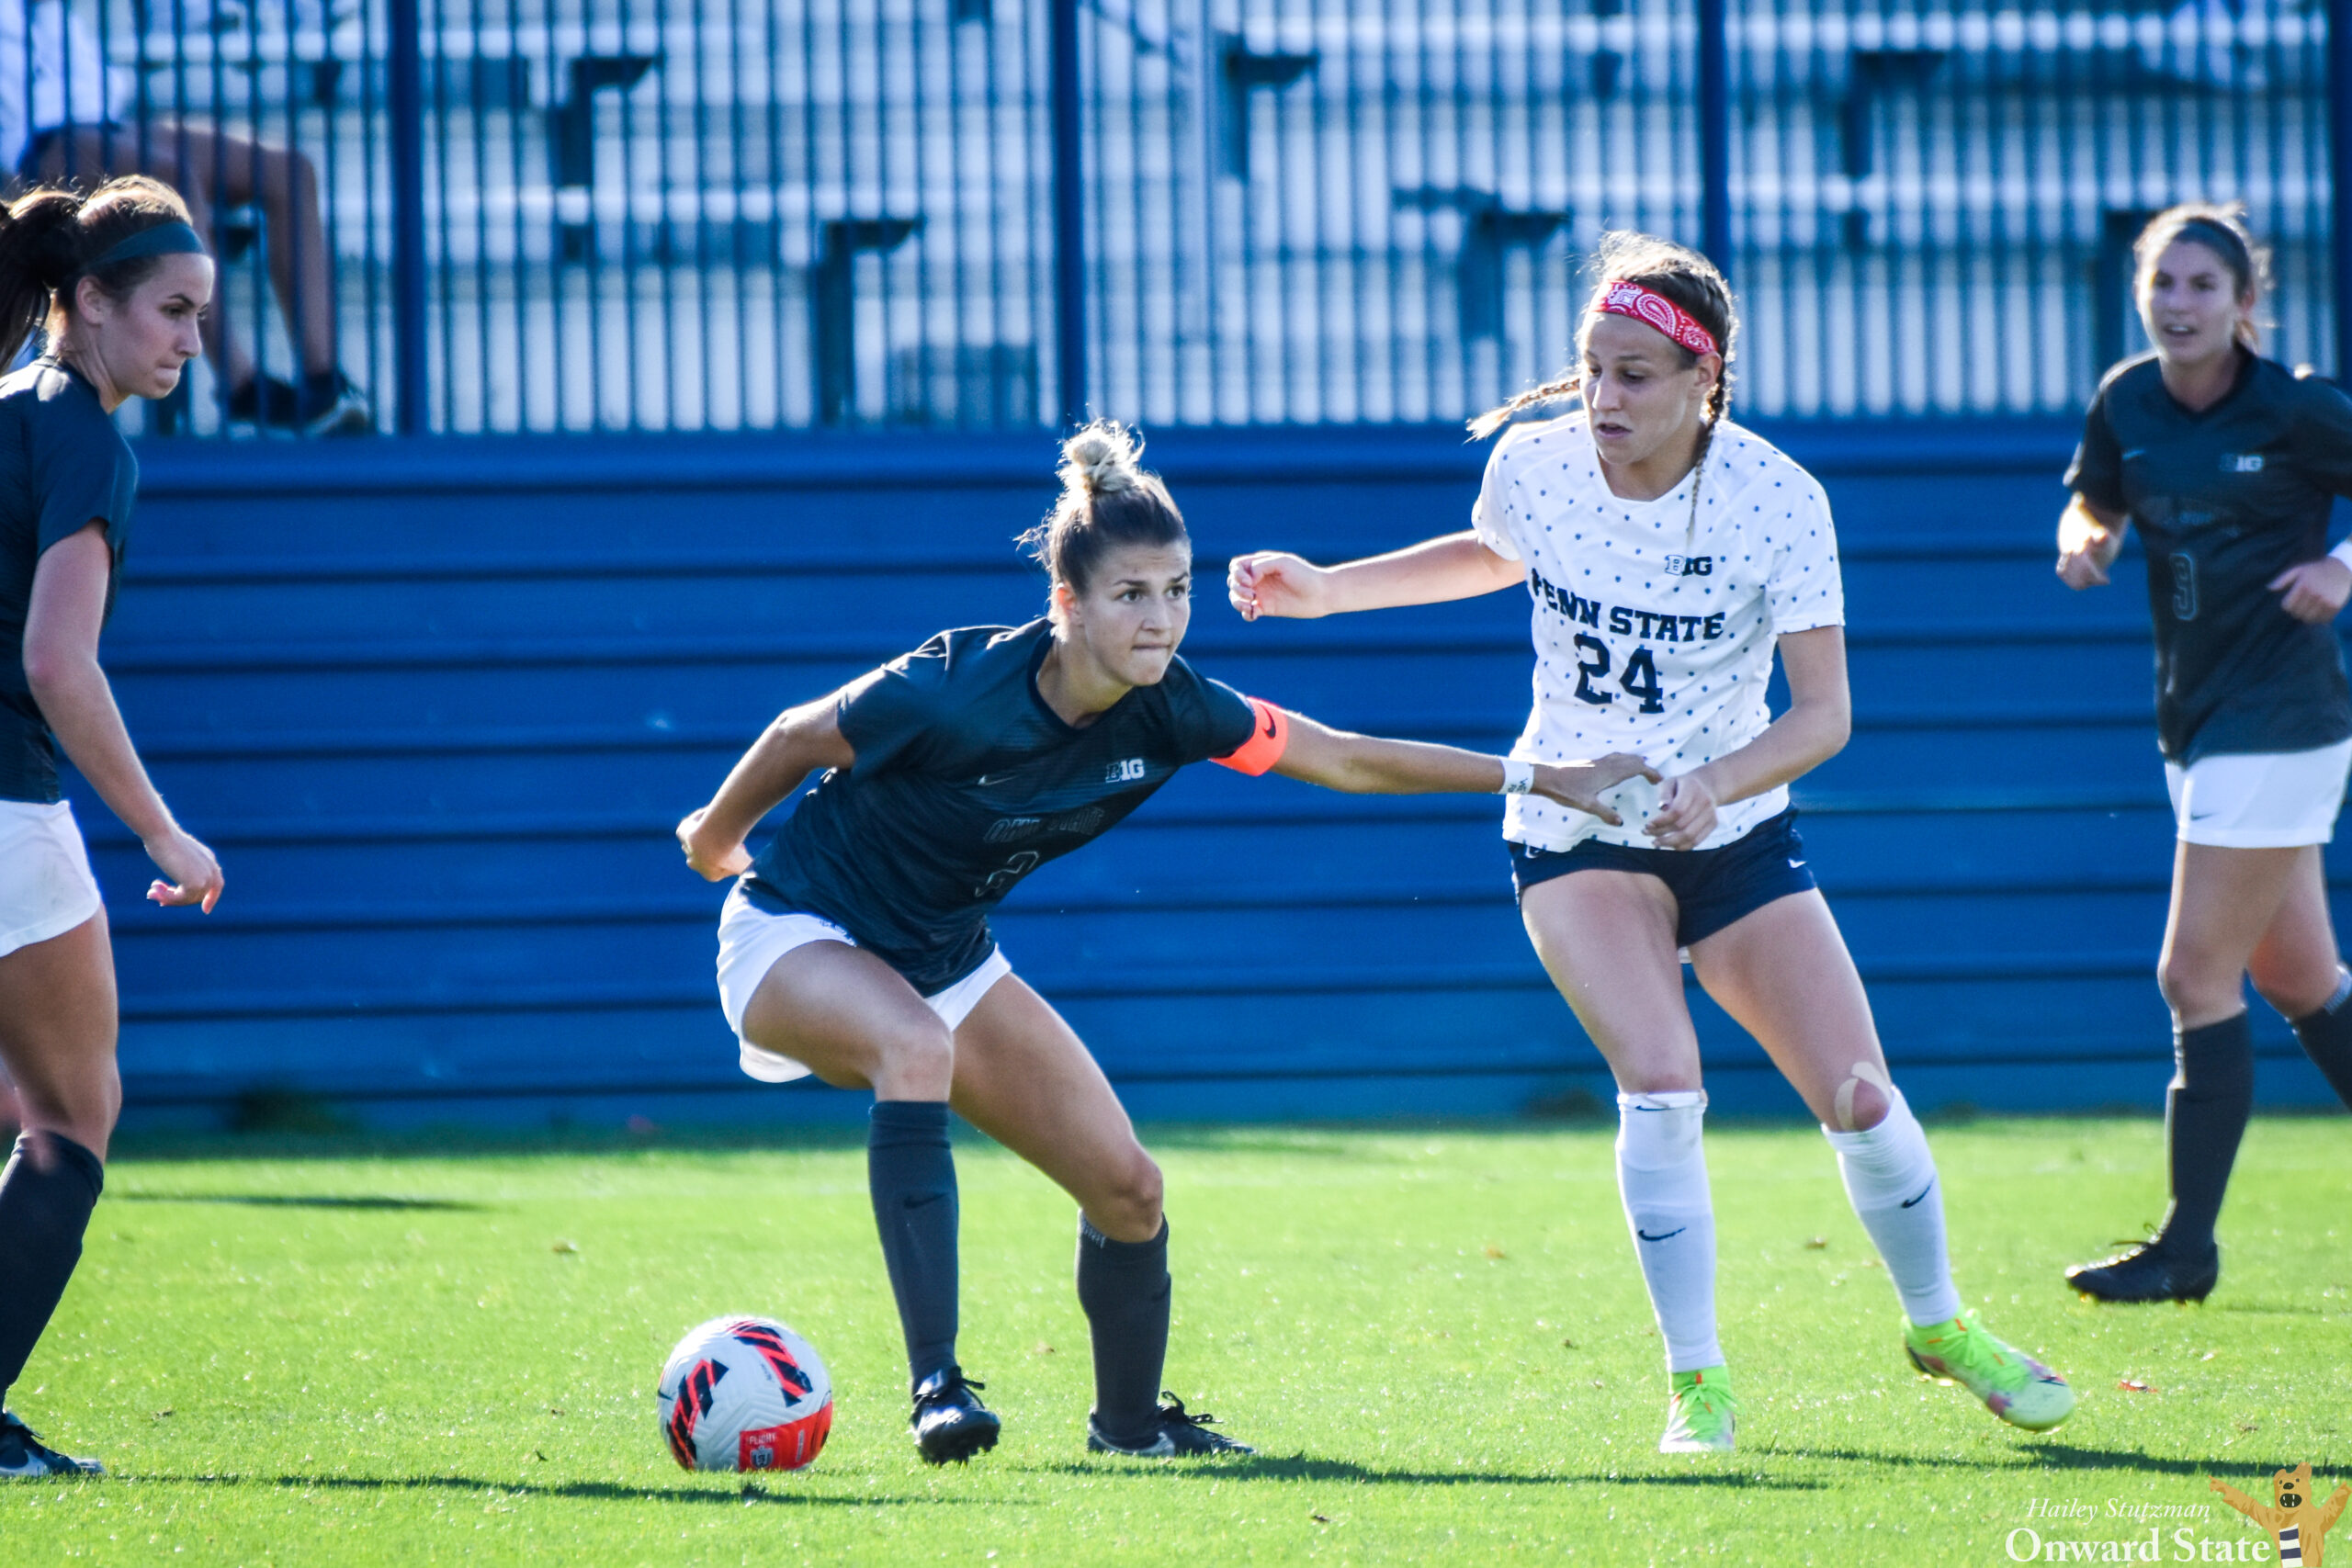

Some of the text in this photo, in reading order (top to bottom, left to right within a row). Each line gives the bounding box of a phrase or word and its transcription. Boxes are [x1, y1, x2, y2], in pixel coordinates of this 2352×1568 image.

[1531, 567, 1725, 642] PENN STATE
[1574, 633, 1665, 714] 24
